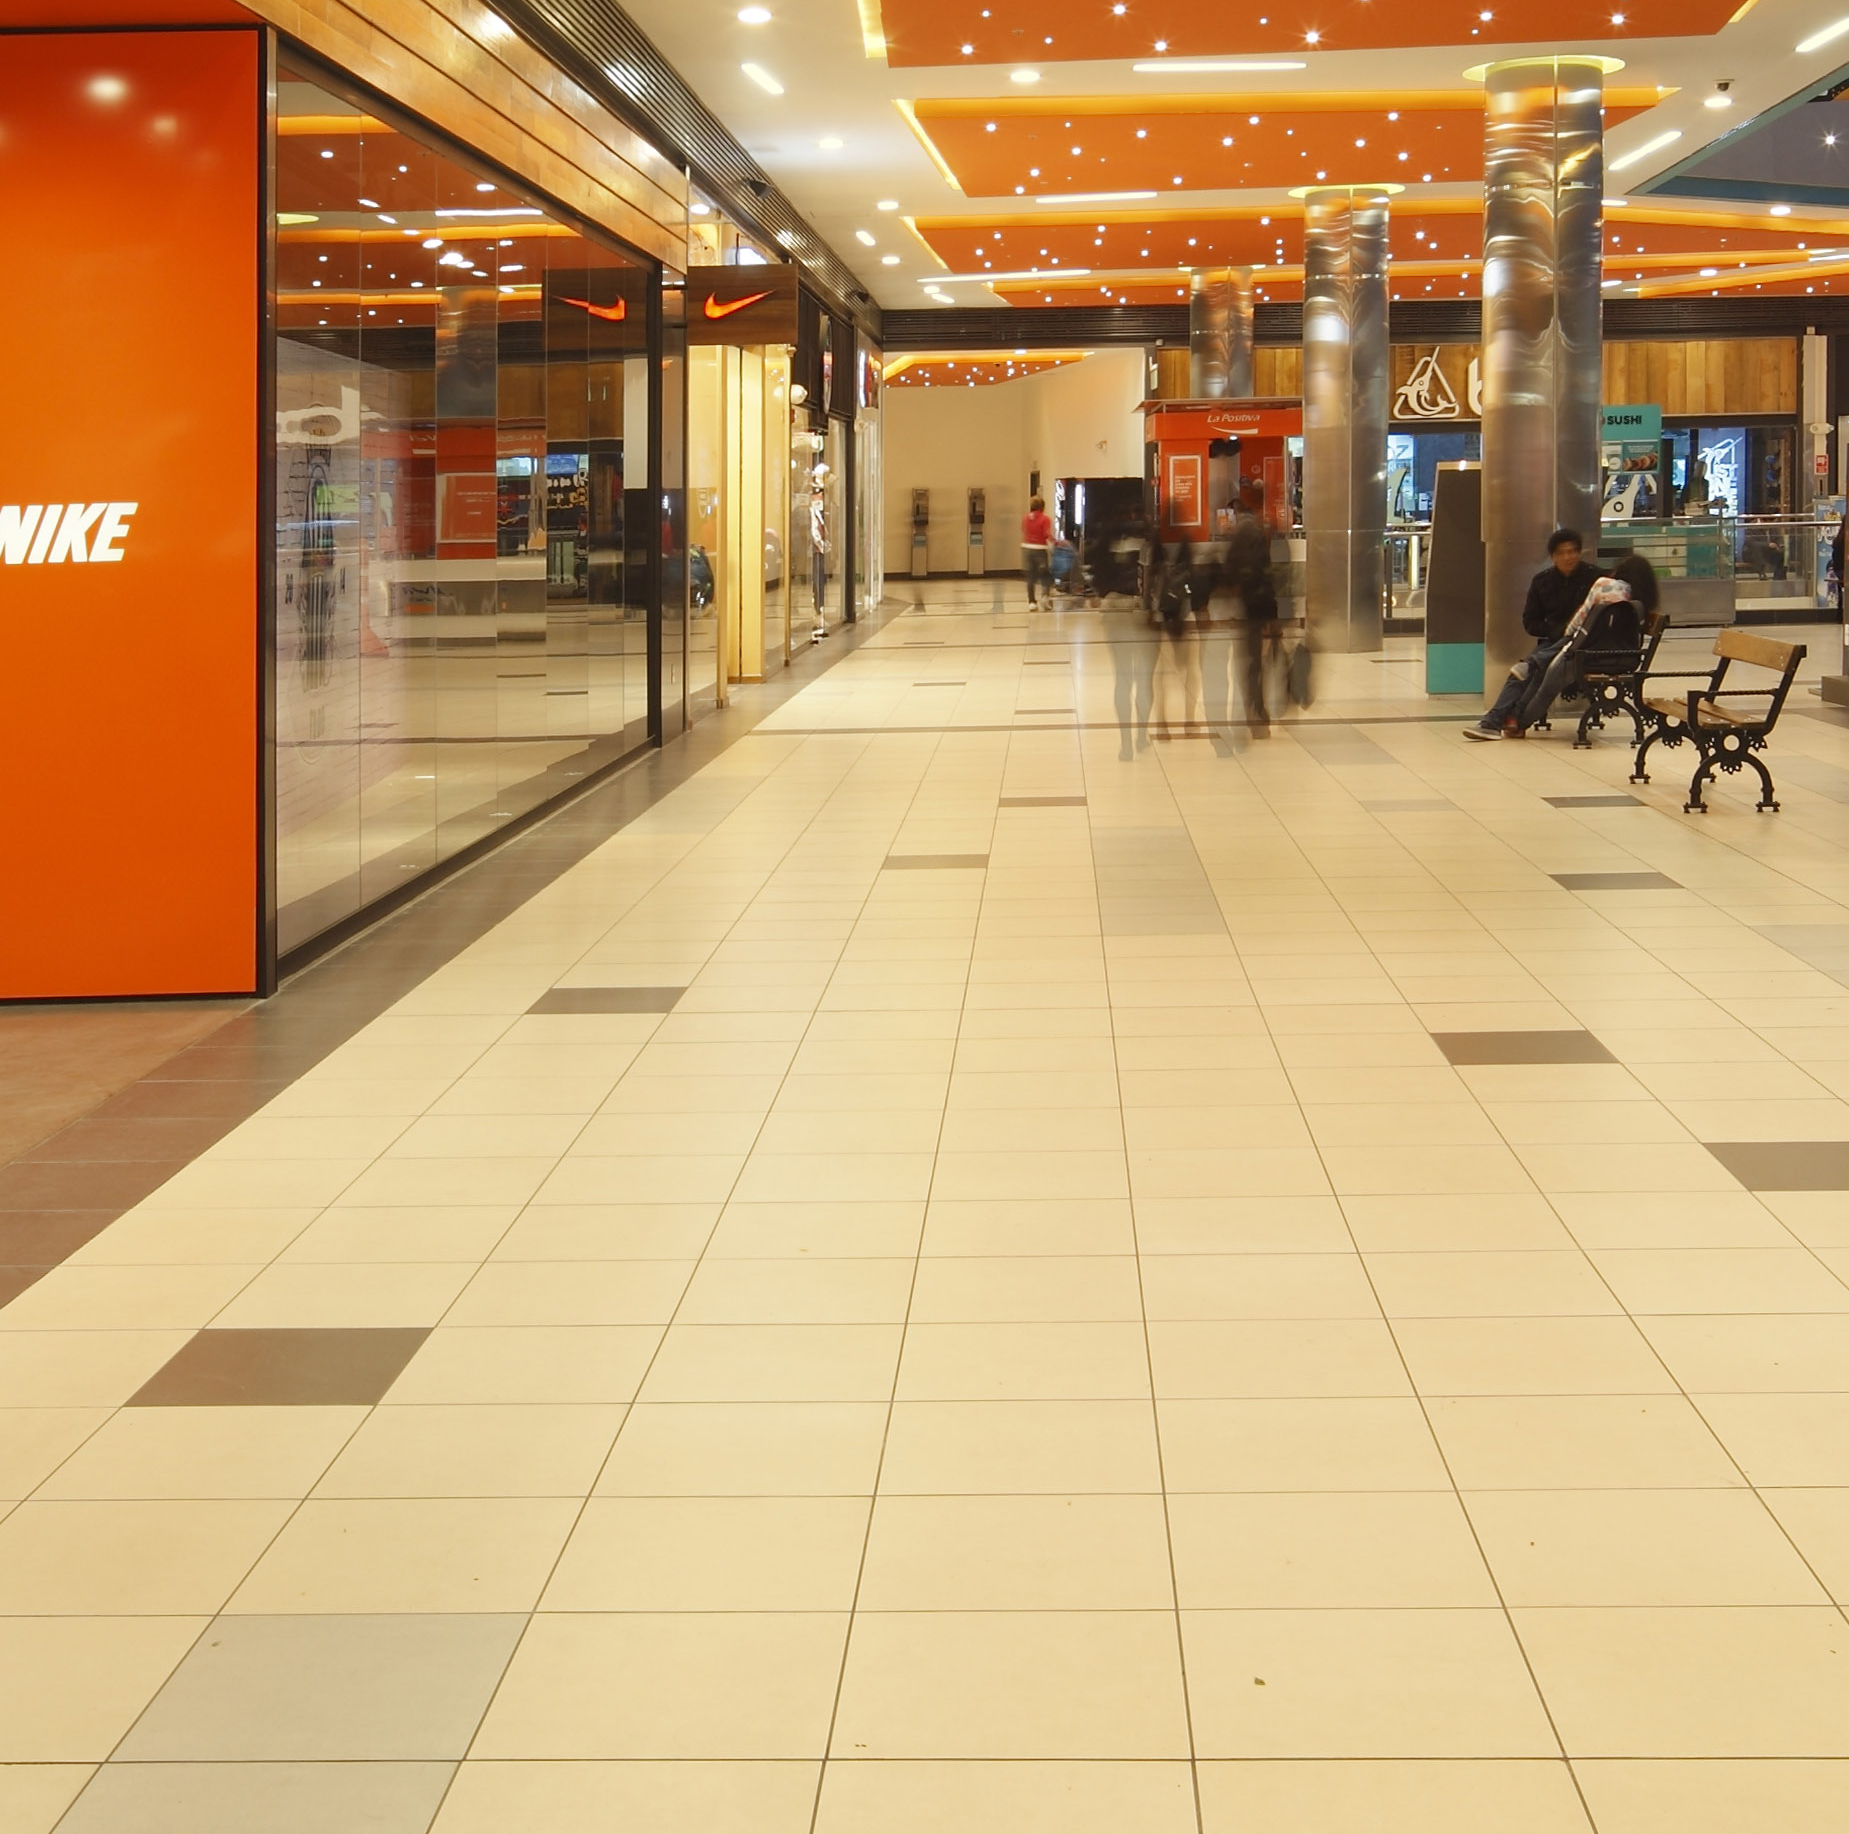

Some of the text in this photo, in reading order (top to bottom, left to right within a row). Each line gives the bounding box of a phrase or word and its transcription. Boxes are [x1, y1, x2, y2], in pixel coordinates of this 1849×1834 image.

[1207, 413, 1261, 423] La Positiva
[1607, 415, 1642, 425] SUSHI
